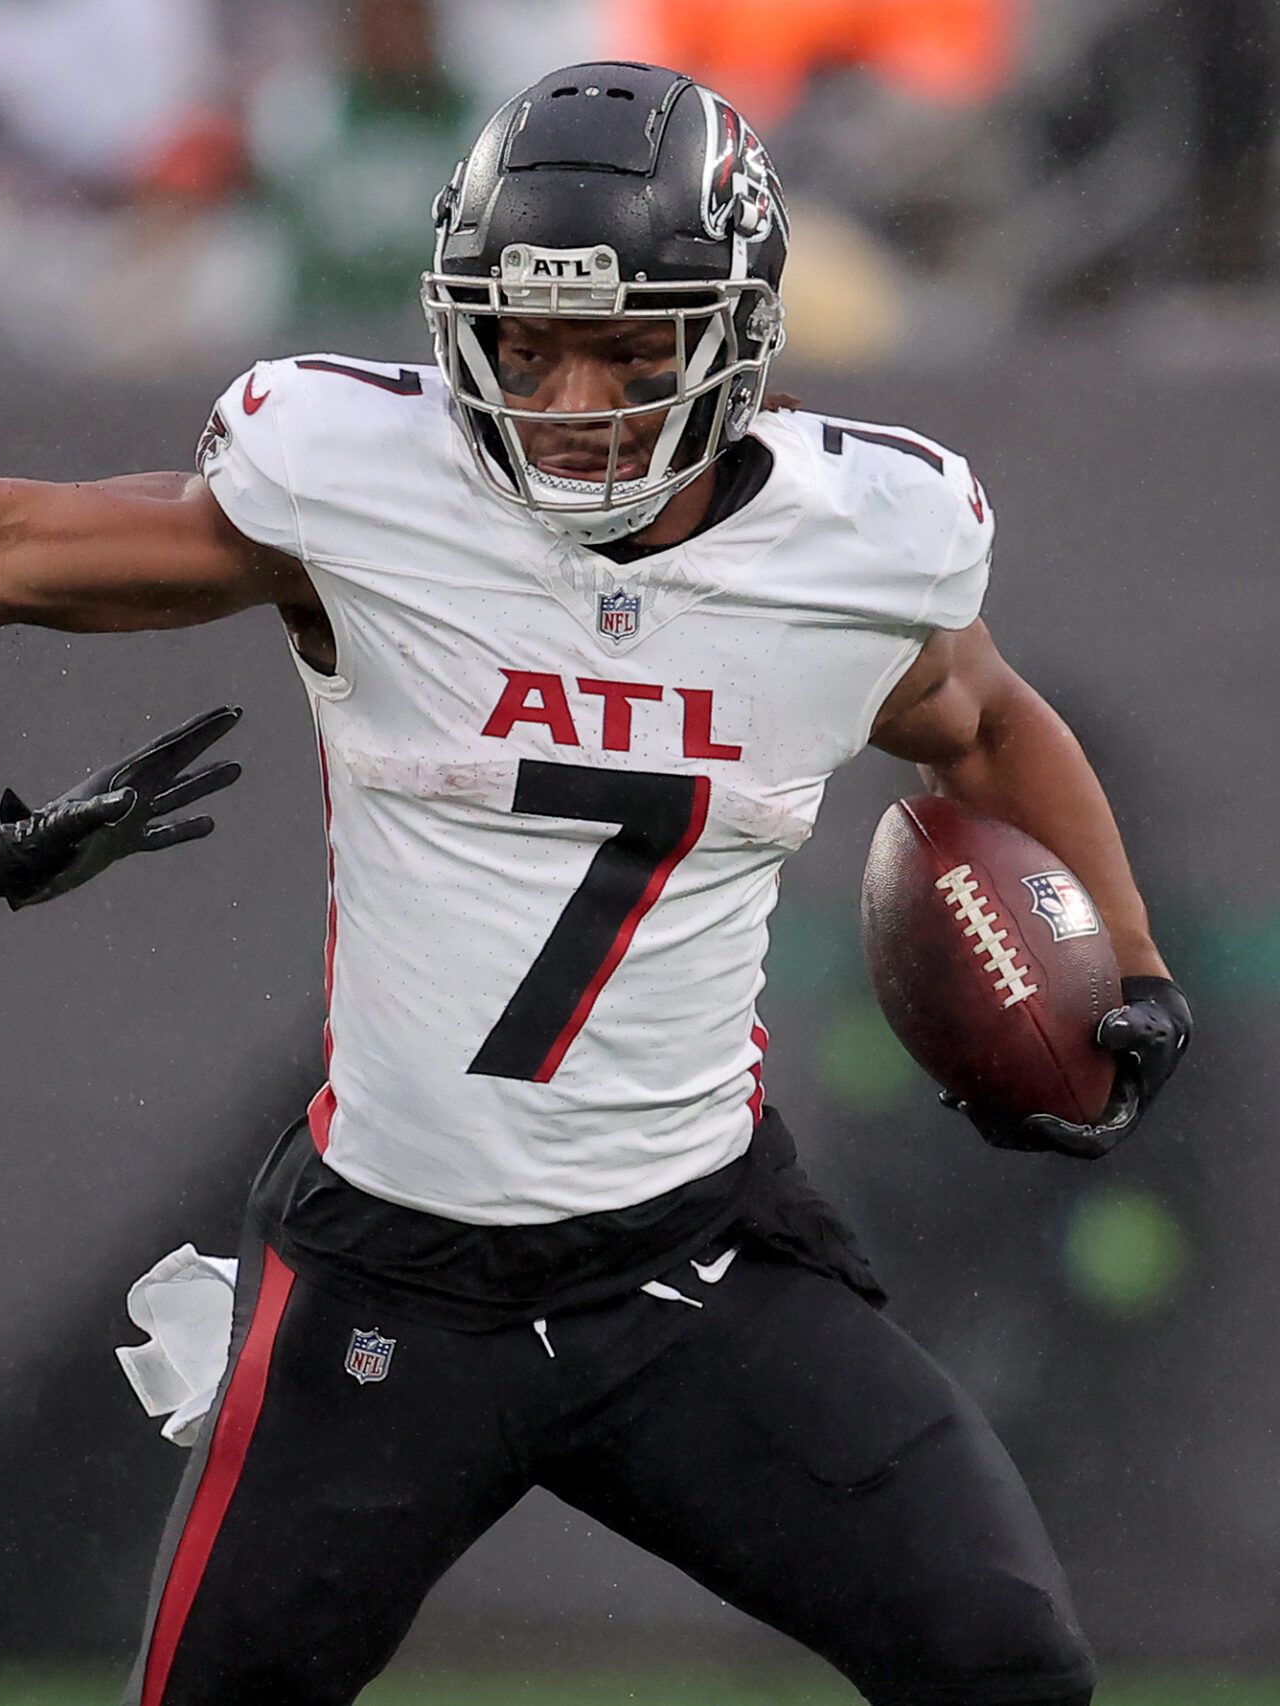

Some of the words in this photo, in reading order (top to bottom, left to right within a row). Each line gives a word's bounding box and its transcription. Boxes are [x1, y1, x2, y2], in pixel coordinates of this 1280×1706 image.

[533, 259, 591, 276] ATL
[603, 612, 634, 634] NFL
[481, 667, 743, 761] ATL
[465, 757, 711, 1084] 7
[351, 1350, 382, 1375] NFL
